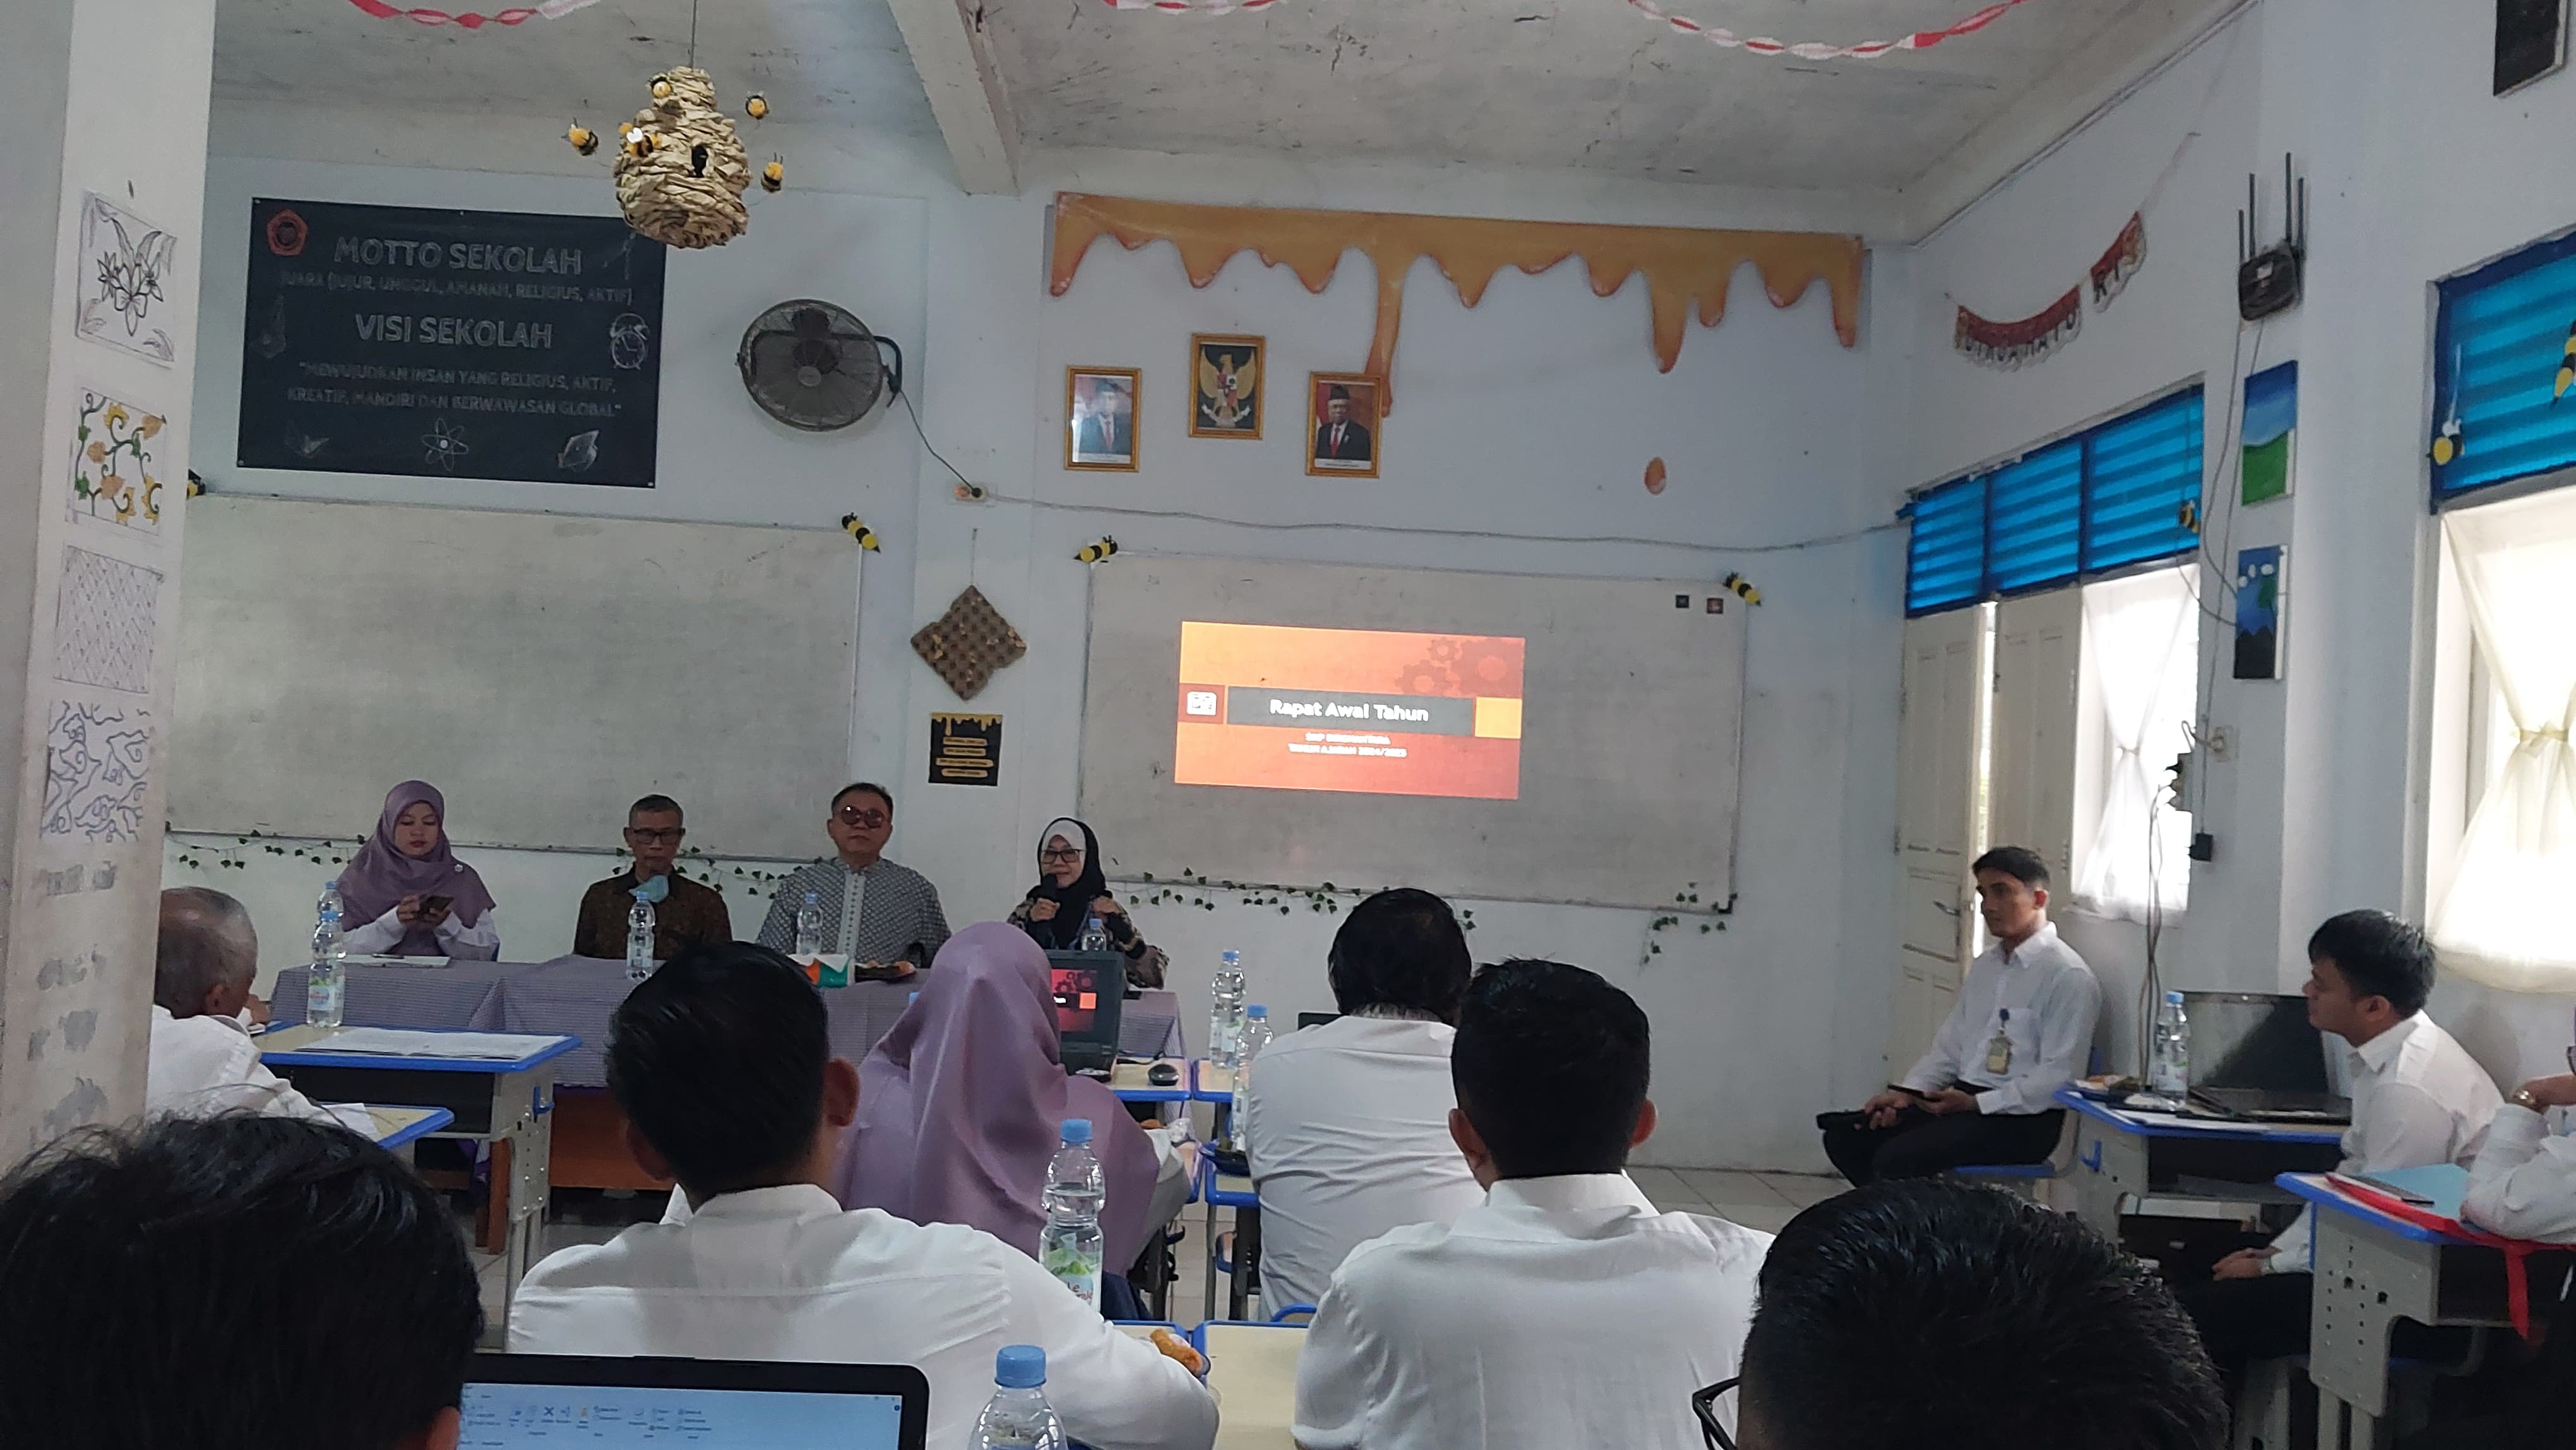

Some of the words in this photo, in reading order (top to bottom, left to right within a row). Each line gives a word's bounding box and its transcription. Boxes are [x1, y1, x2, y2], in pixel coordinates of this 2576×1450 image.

[334, 236, 443, 268] MOTTO
[449, 243, 581, 275] SEKOLAH
[355, 313, 412, 343] VISI
[419, 316, 552, 349] SEKOLAH
[458, 370, 498, 385] YANG
[453, 395, 555, 414] BERWAWASAN
[1270, 698, 1323, 719] Rapat
[1325, 702, 1369, 719] Awal
[1373, 704, 1429, 722] Tahun
